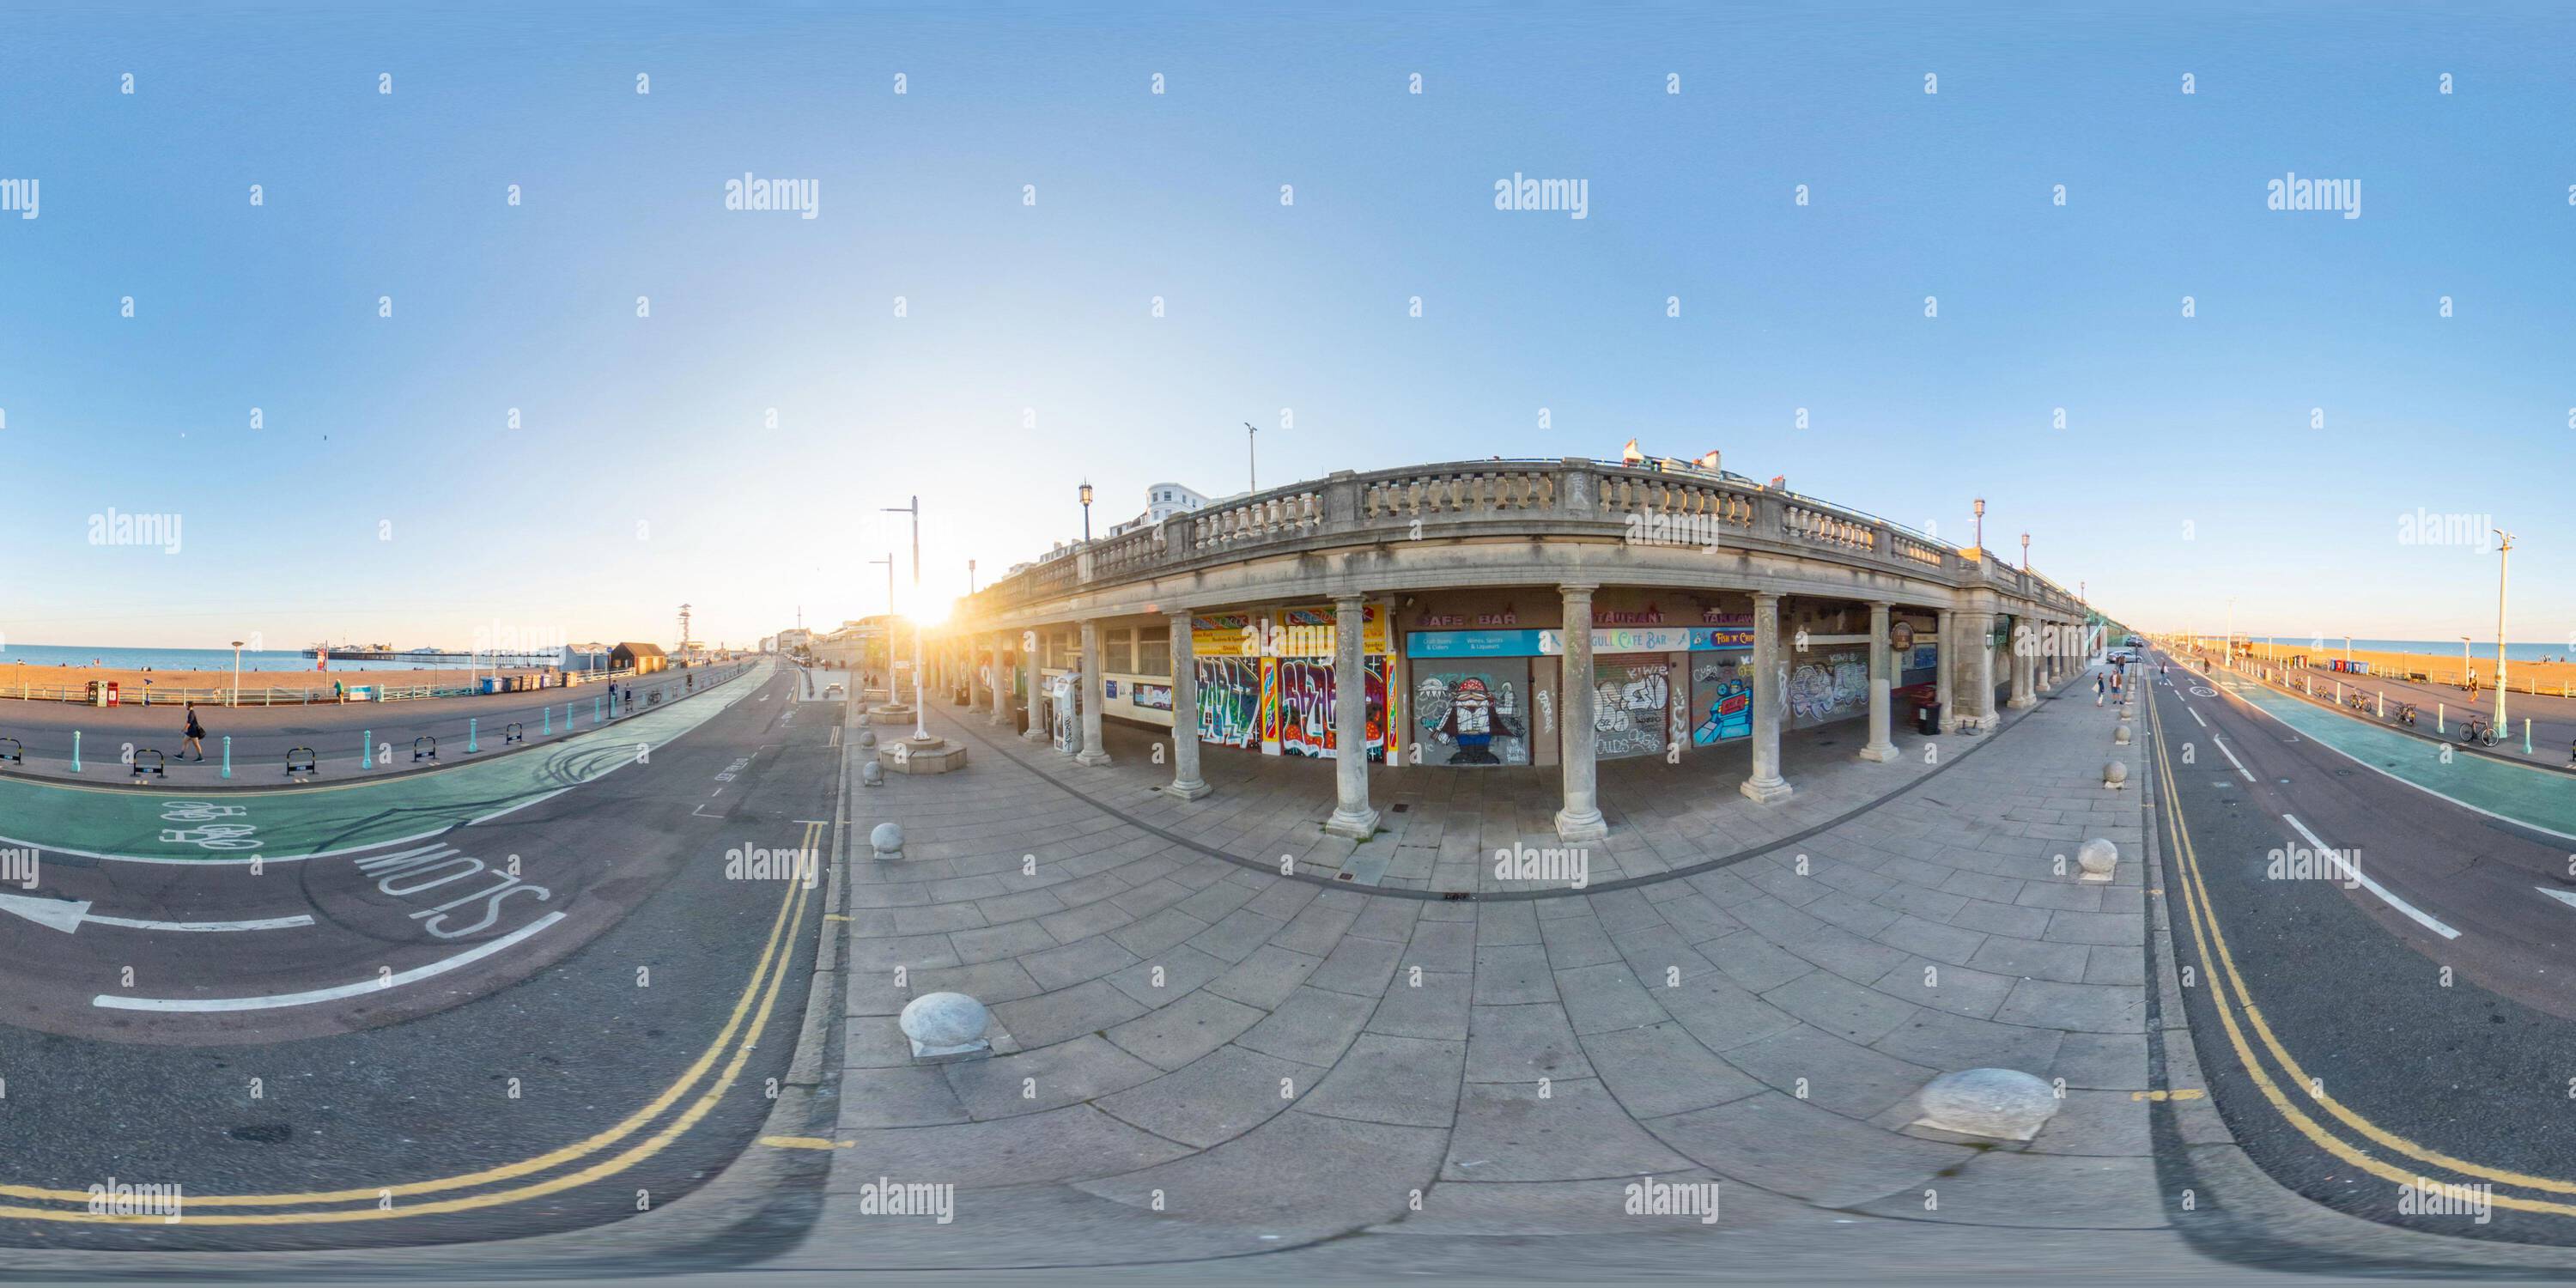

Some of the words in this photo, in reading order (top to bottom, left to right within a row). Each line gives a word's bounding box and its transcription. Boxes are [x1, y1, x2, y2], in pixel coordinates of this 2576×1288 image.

[1478, 613, 1517, 625] BAR
[1594, 611, 1665, 625] TAURANT
[1591, 635, 1615, 647] GULL
[1646, 631, 1668, 649] BAR
[1740, 632, 1755, 645] CHIP
[353, 841, 550, 939] SLOW
